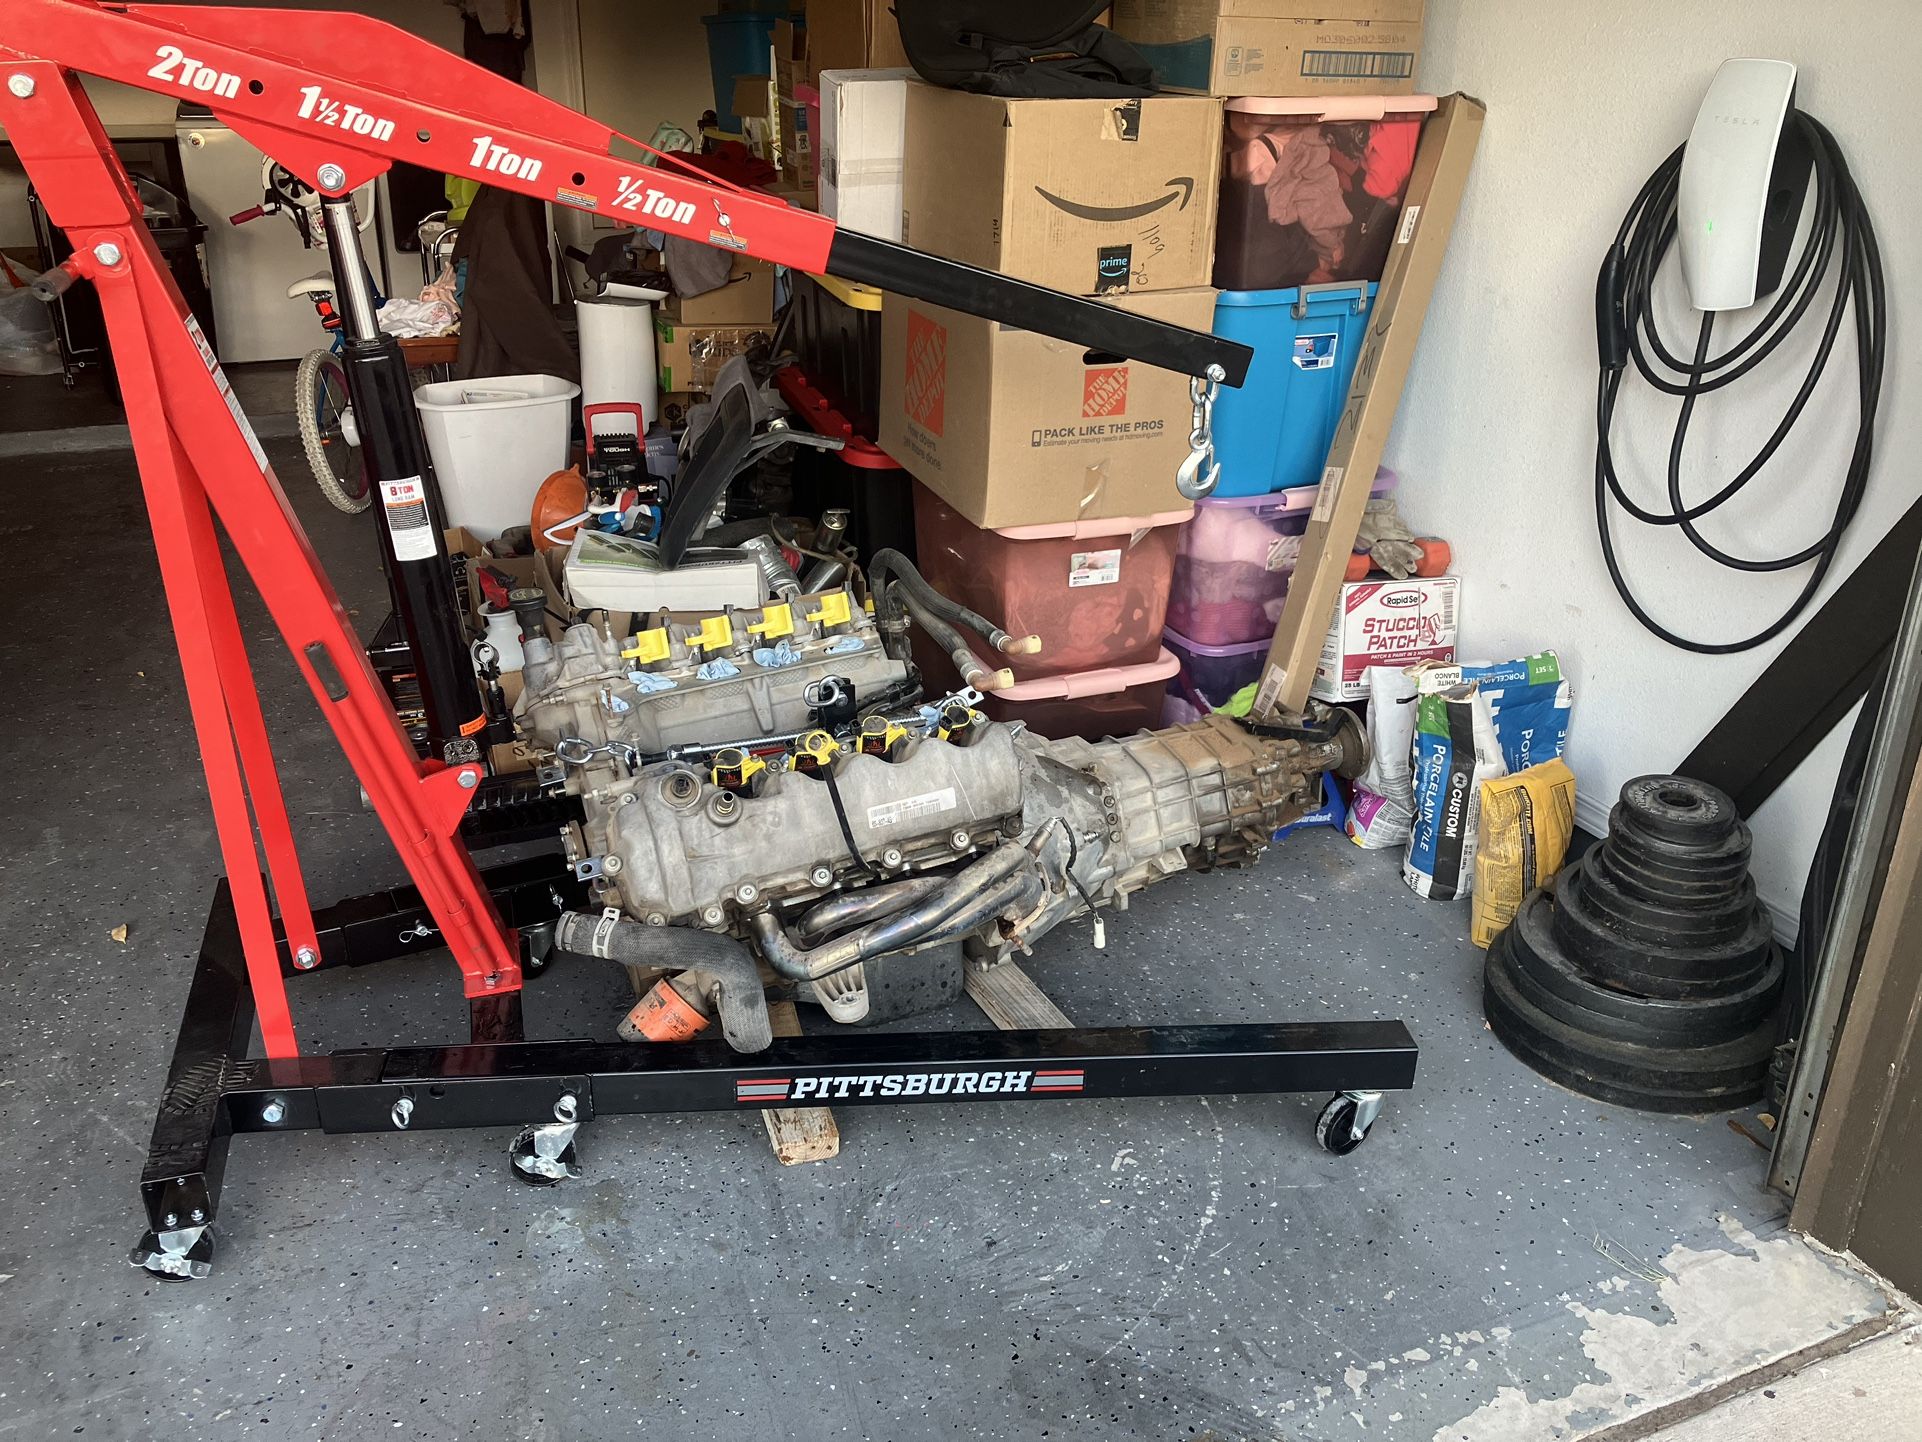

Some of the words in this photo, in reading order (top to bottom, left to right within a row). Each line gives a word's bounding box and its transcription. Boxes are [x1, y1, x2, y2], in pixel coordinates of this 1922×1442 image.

[1714, 115, 1761, 126] TESLA
[1099, 256, 1128, 269] prime
[1083, 367, 1128, 417] HOME
[1087, 373, 1107, 393] THE
[1100, 386, 1127, 416] DEPOT
[1044, 427, 1075, 438] PACK
[1079, 425, 1105, 436] LIKE
[1108, 423, 1131, 433] THE
[1134, 419, 1164, 431] PROS
[399, 485, 414, 495] TON
[1386, 596, 1409, 606] Rapid
[1409, 595, 1420, 604] Se
[1362, 616, 1428, 634] STUCCO
[1367, 635, 1419, 651] PATCH
[1423, 744, 1447, 824] PORCELAIN
[1445, 788, 1463, 838] CUSTOM
[790, 1070, 1034, 1099] PITTSBURGH
